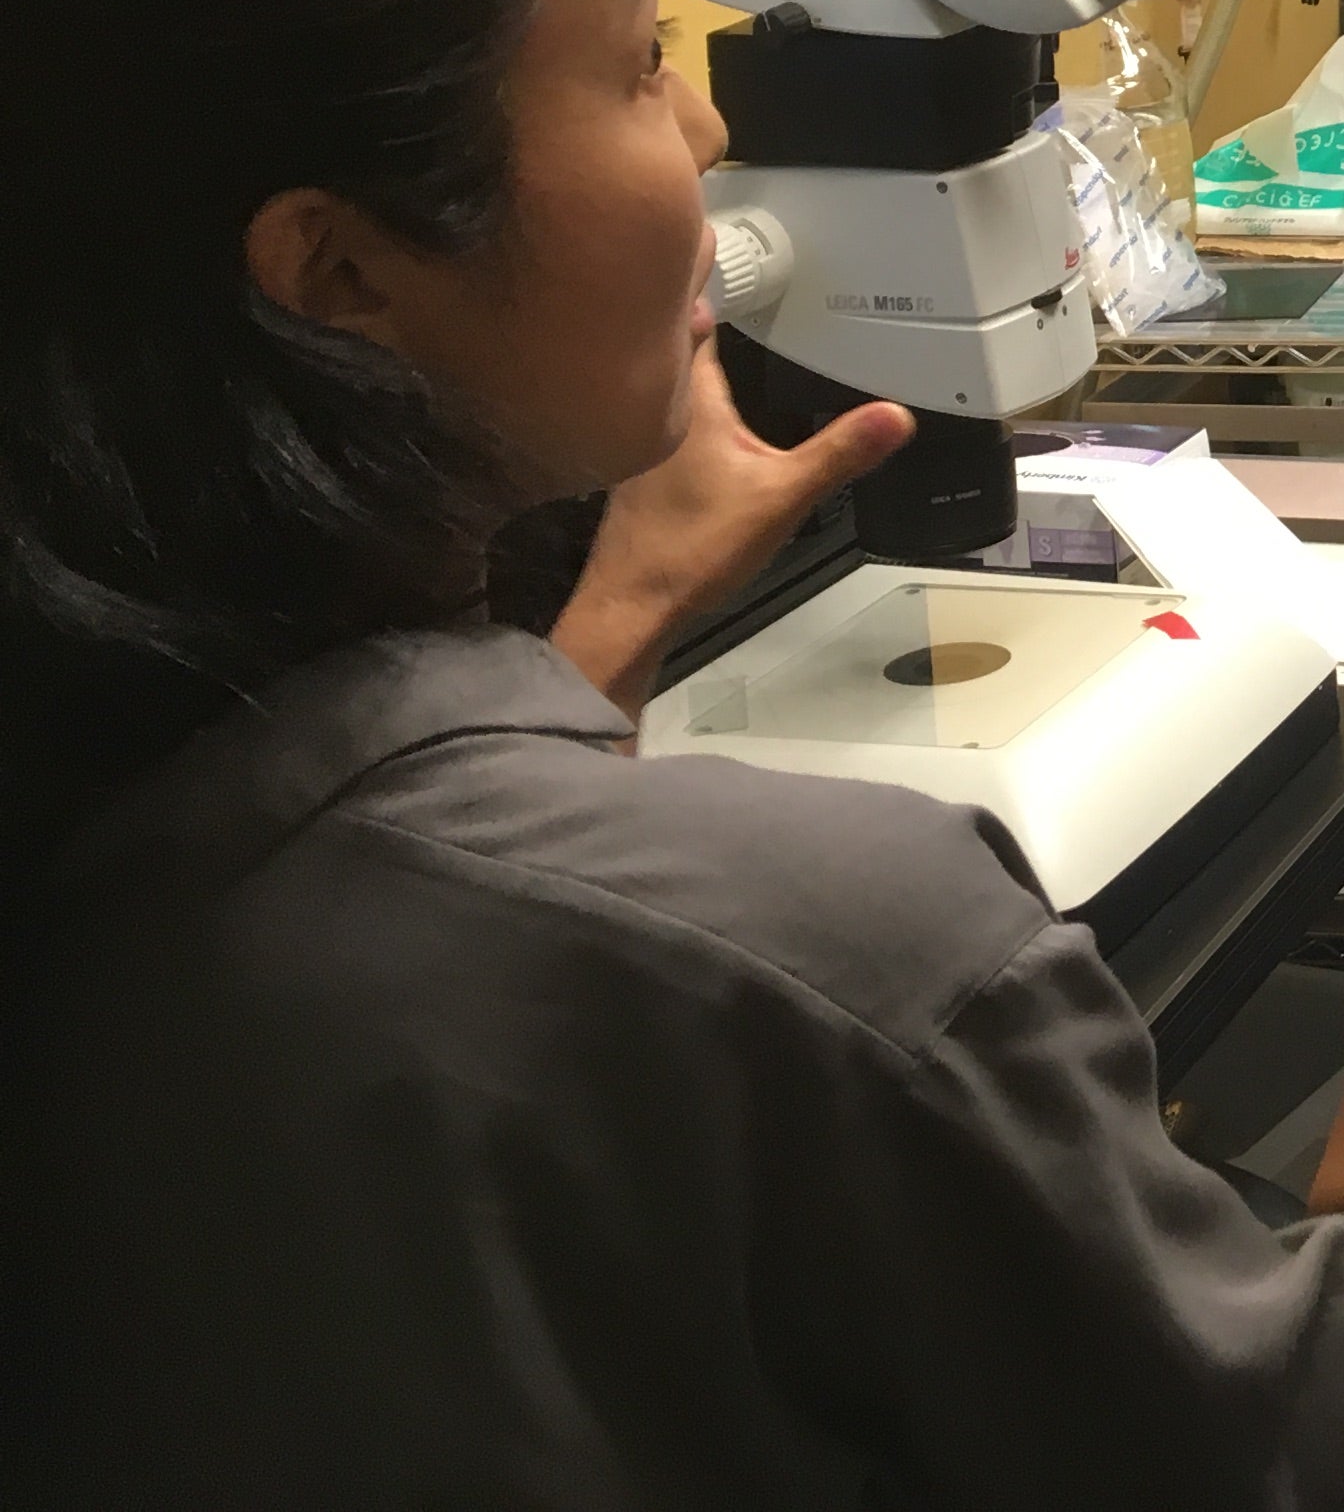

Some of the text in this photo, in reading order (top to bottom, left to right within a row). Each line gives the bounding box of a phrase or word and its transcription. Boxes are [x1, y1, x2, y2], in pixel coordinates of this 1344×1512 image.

[825, 294, 935, 313] LEICA M165 FC
[1039, 535, 1052, 556] S
